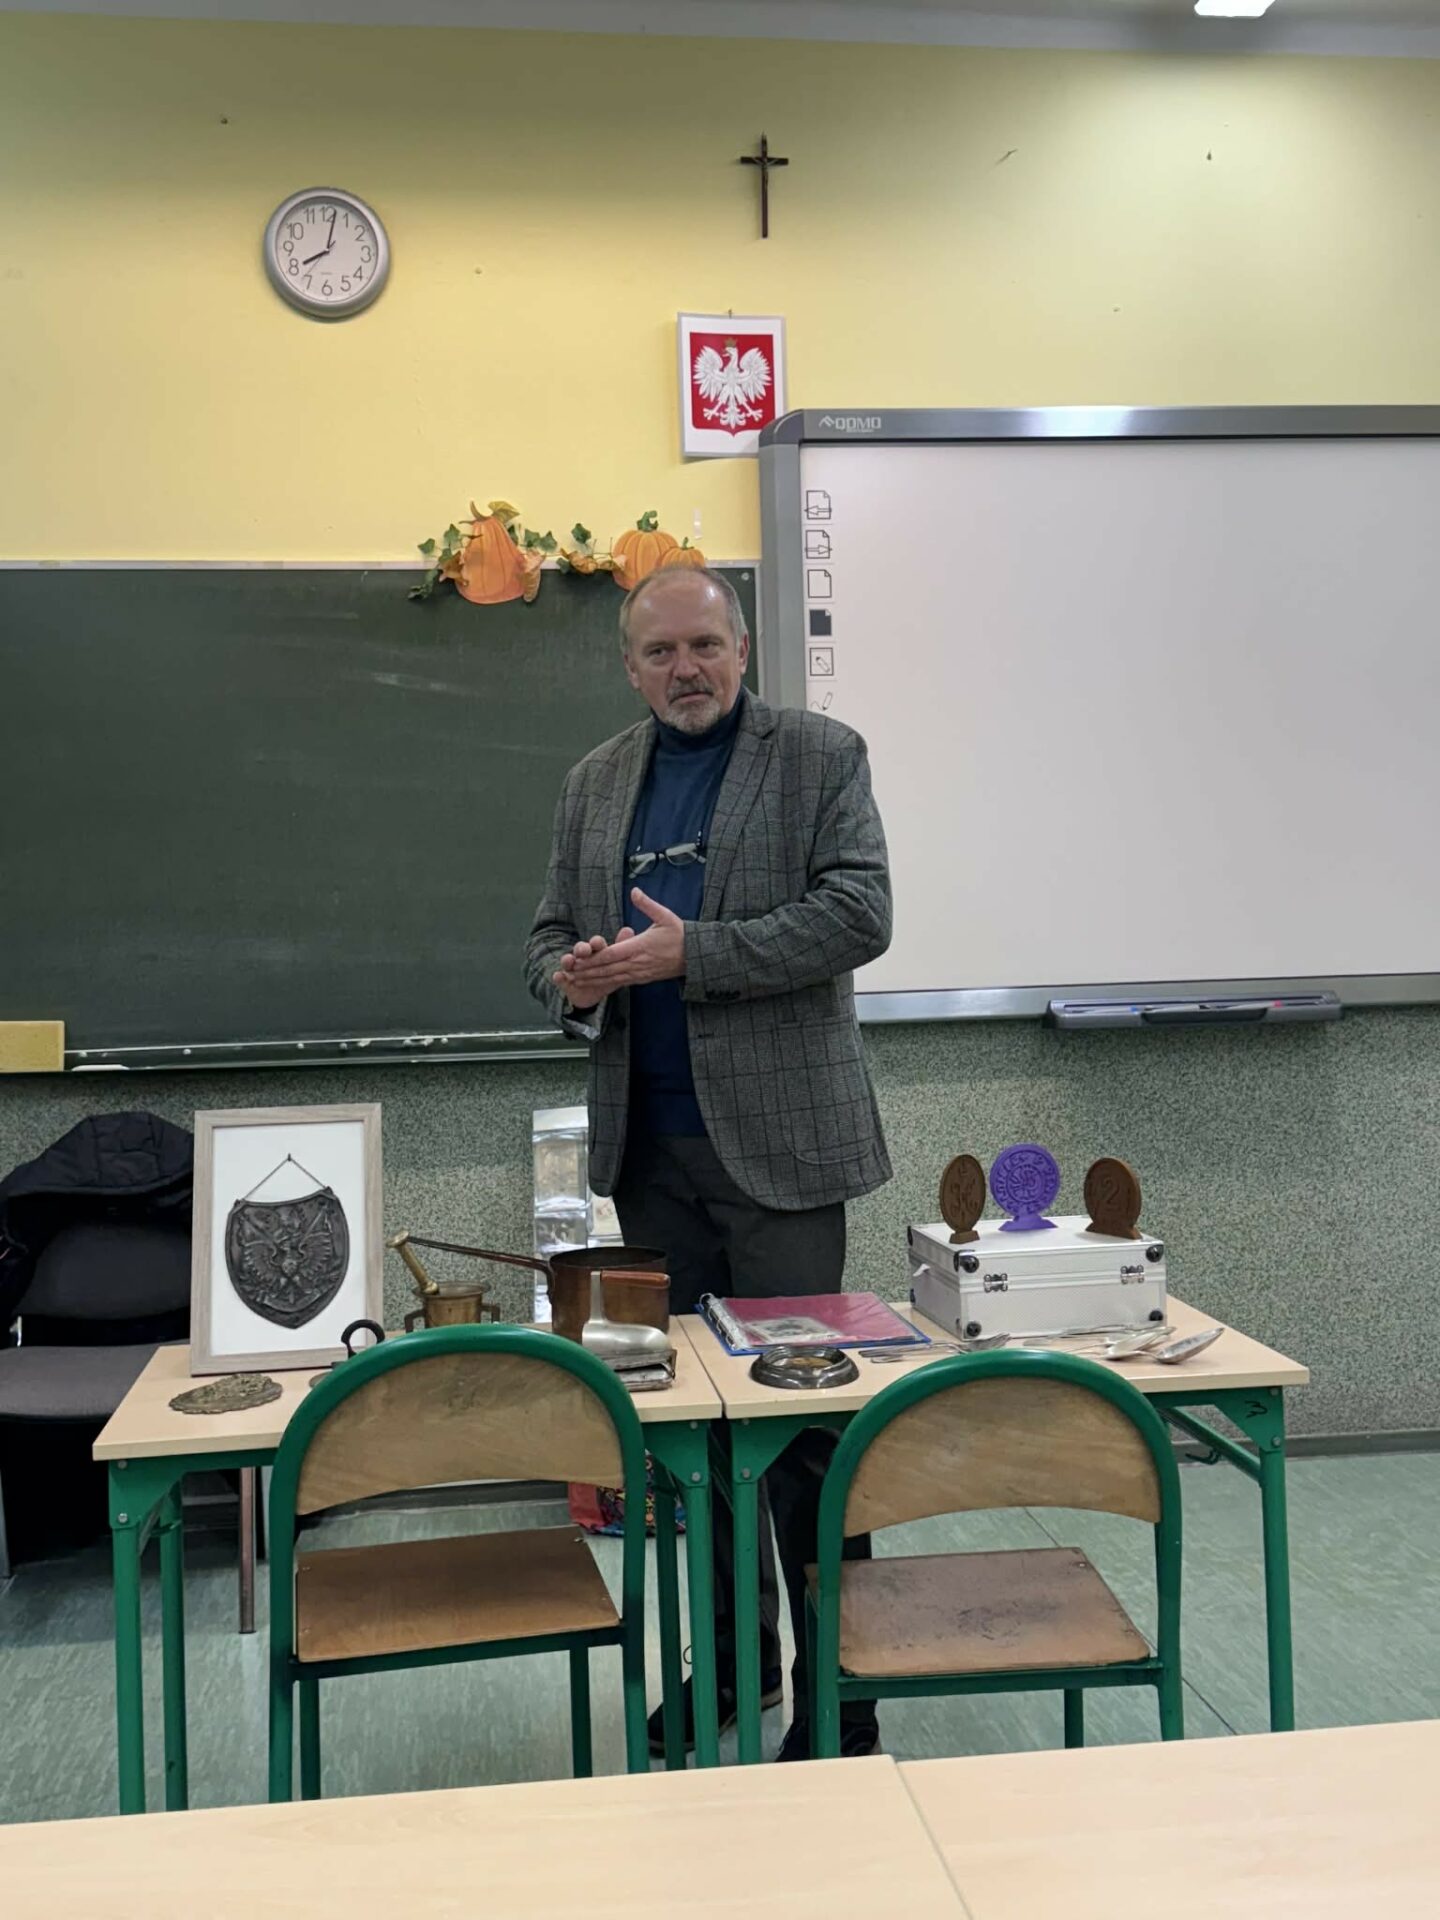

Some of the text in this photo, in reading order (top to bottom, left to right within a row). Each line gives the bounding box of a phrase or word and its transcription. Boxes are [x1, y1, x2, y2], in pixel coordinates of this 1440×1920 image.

[304, 208, 315, 224] 11
[320, 206, 337, 223] 12
[343, 213, 349, 228] 1
[286, 222, 304, 240] 10
[354, 224, 366, 242] 2
[283, 240, 294, 256] 9
[361, 245, 372, 263] 3
[289, 258, 299, 276] 8
[352, 265, 363, 281] 4
[303, 274, 313, 290] 7
[322, 280, 333, 296] 6
[340, 275, 352, 292] 5
[835, 416, 881, 430] QOMO
